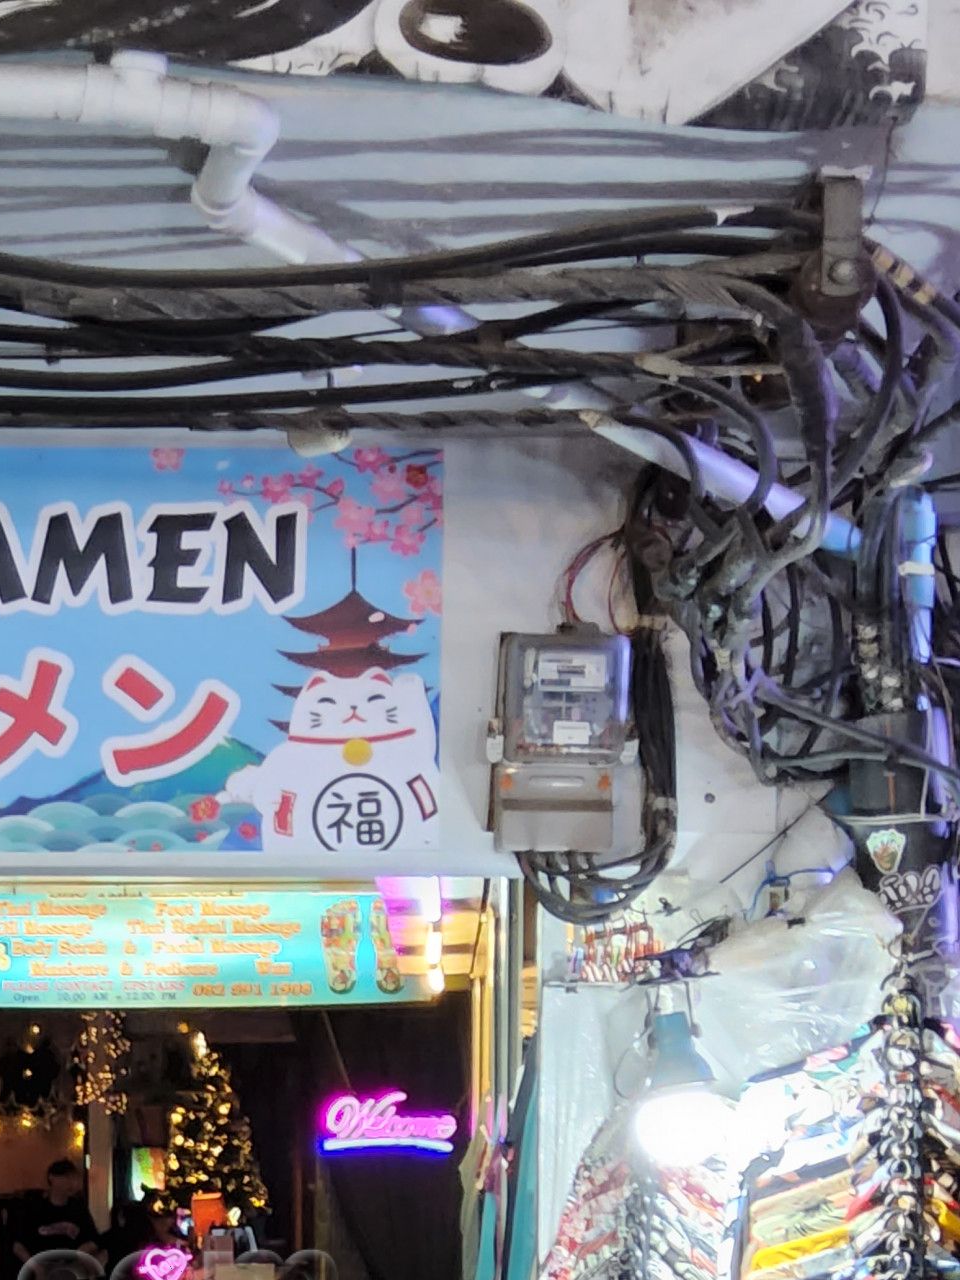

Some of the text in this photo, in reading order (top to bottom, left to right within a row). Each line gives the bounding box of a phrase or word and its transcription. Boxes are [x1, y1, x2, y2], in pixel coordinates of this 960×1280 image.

[326, 791, 385, 846] 福
[37, 901, 107, 919] Massage
[201, 902, 270, 920] Massage
[23, 920, 92, 938] Massage
[232, 919, 301, 938] Massage
[211, 940, 279, 957] Massage
